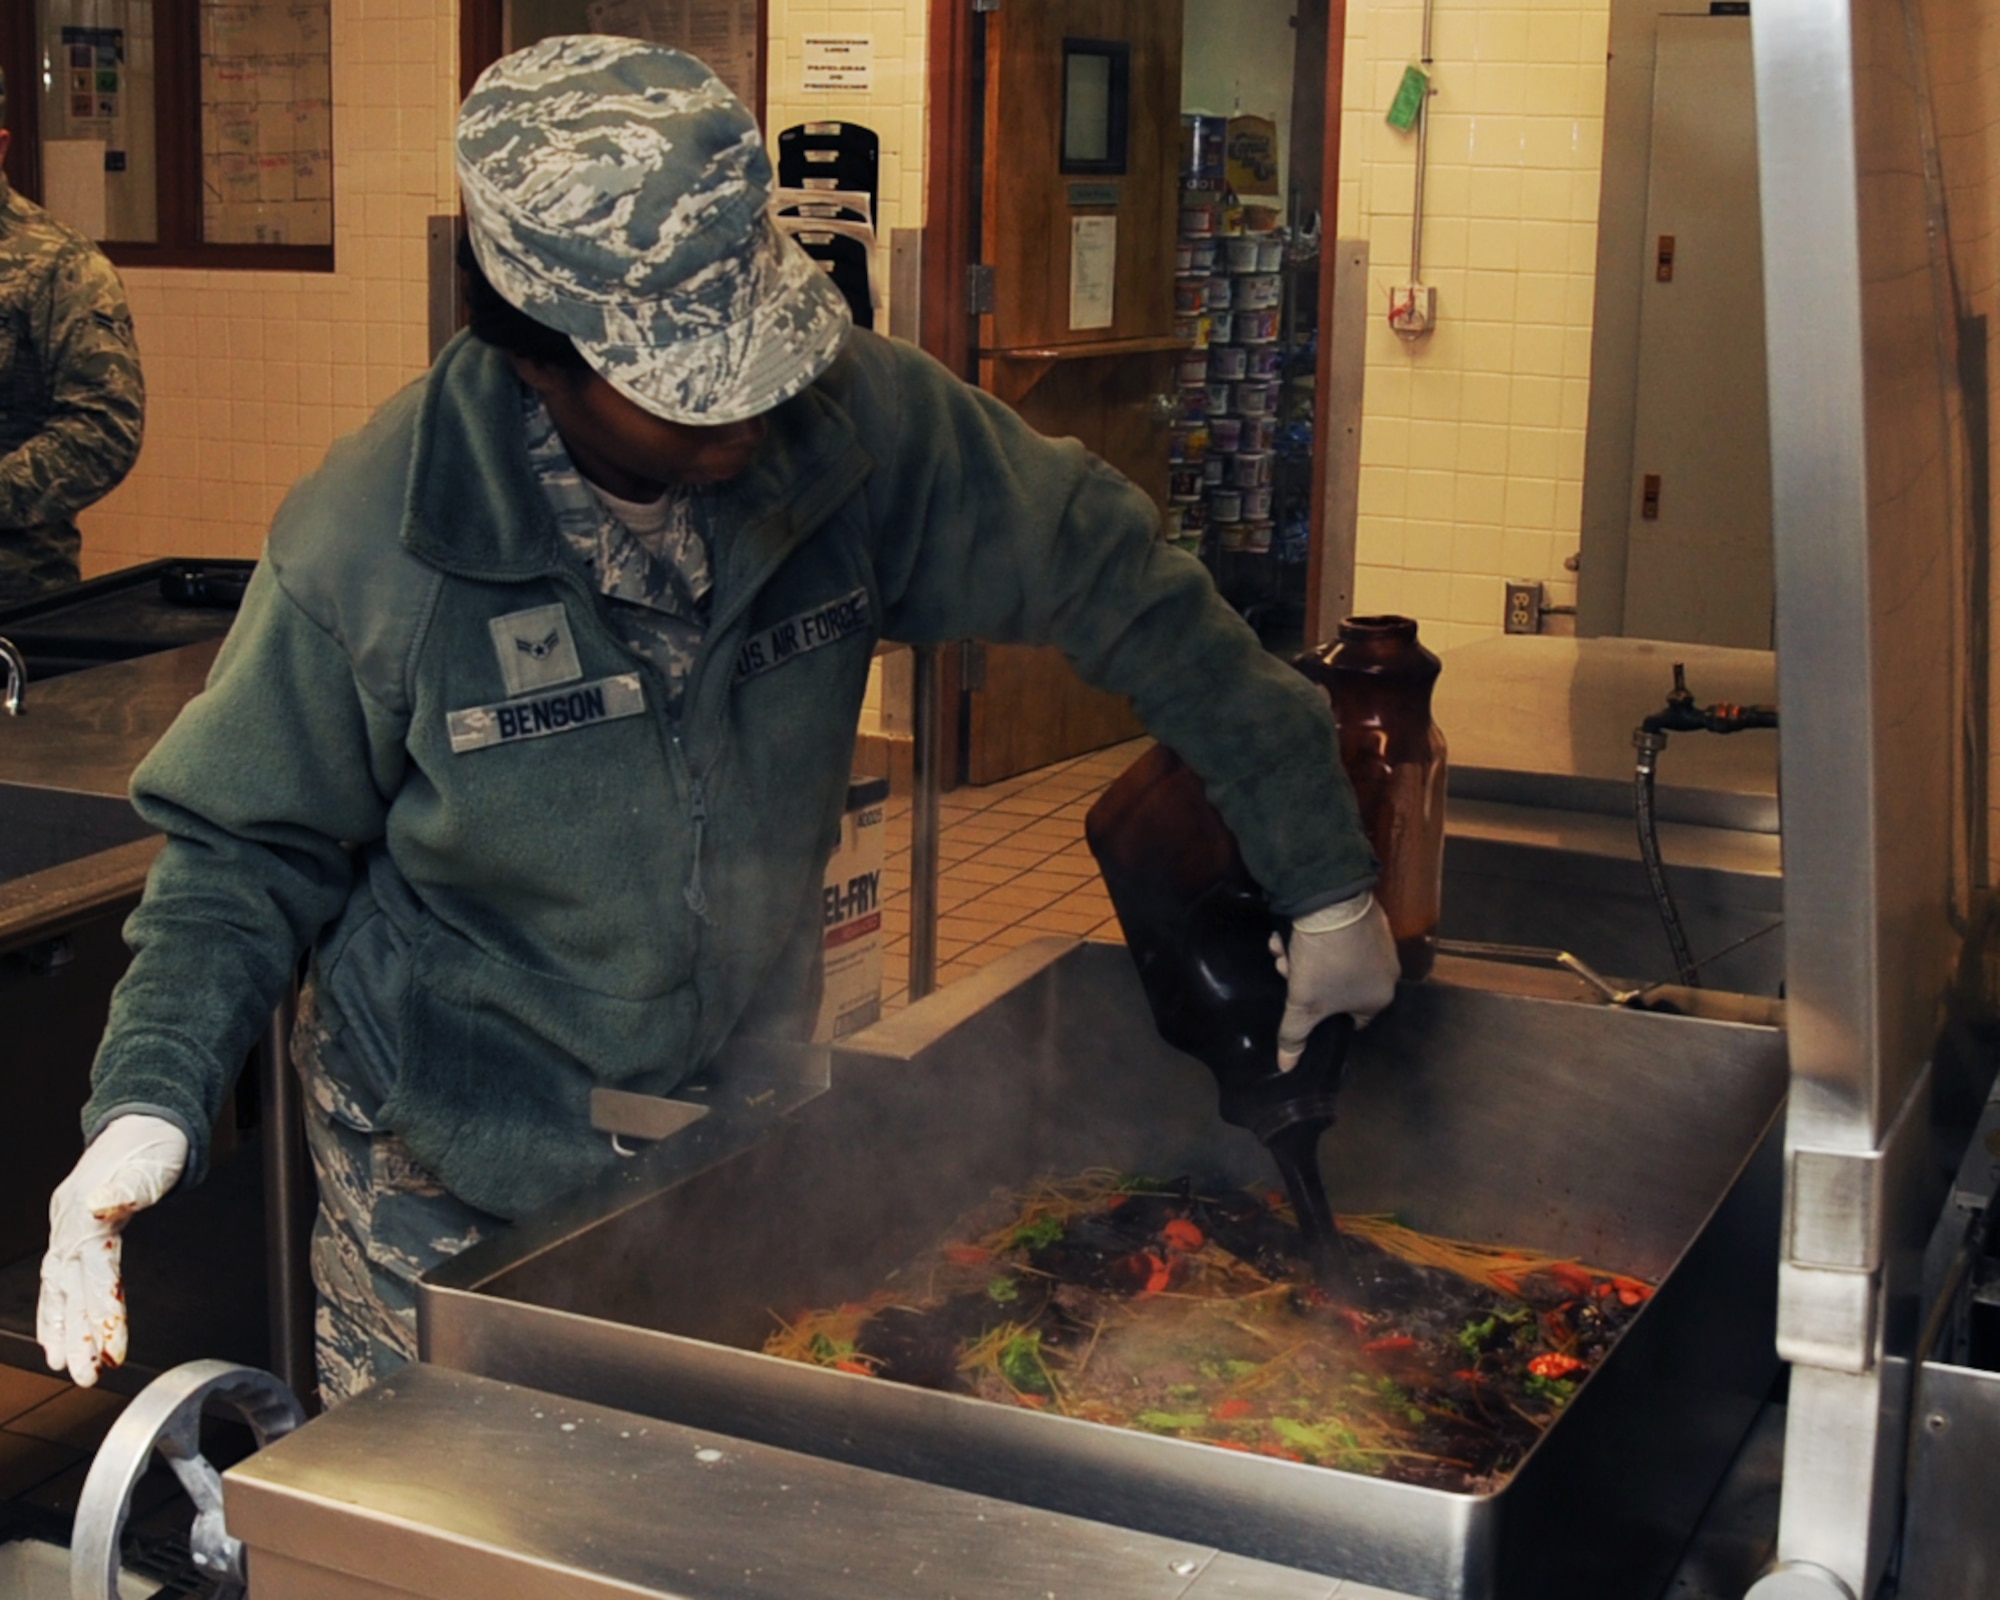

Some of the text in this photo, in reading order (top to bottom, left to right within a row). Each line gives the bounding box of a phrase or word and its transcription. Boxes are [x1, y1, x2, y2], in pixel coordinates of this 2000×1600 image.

[771, 622, 799, 661] AIR
[802, 597, 866, 646] FORCE
[498, 688, 606, 739] BENSON
[823, 868, 880, 924] EL-FRY
